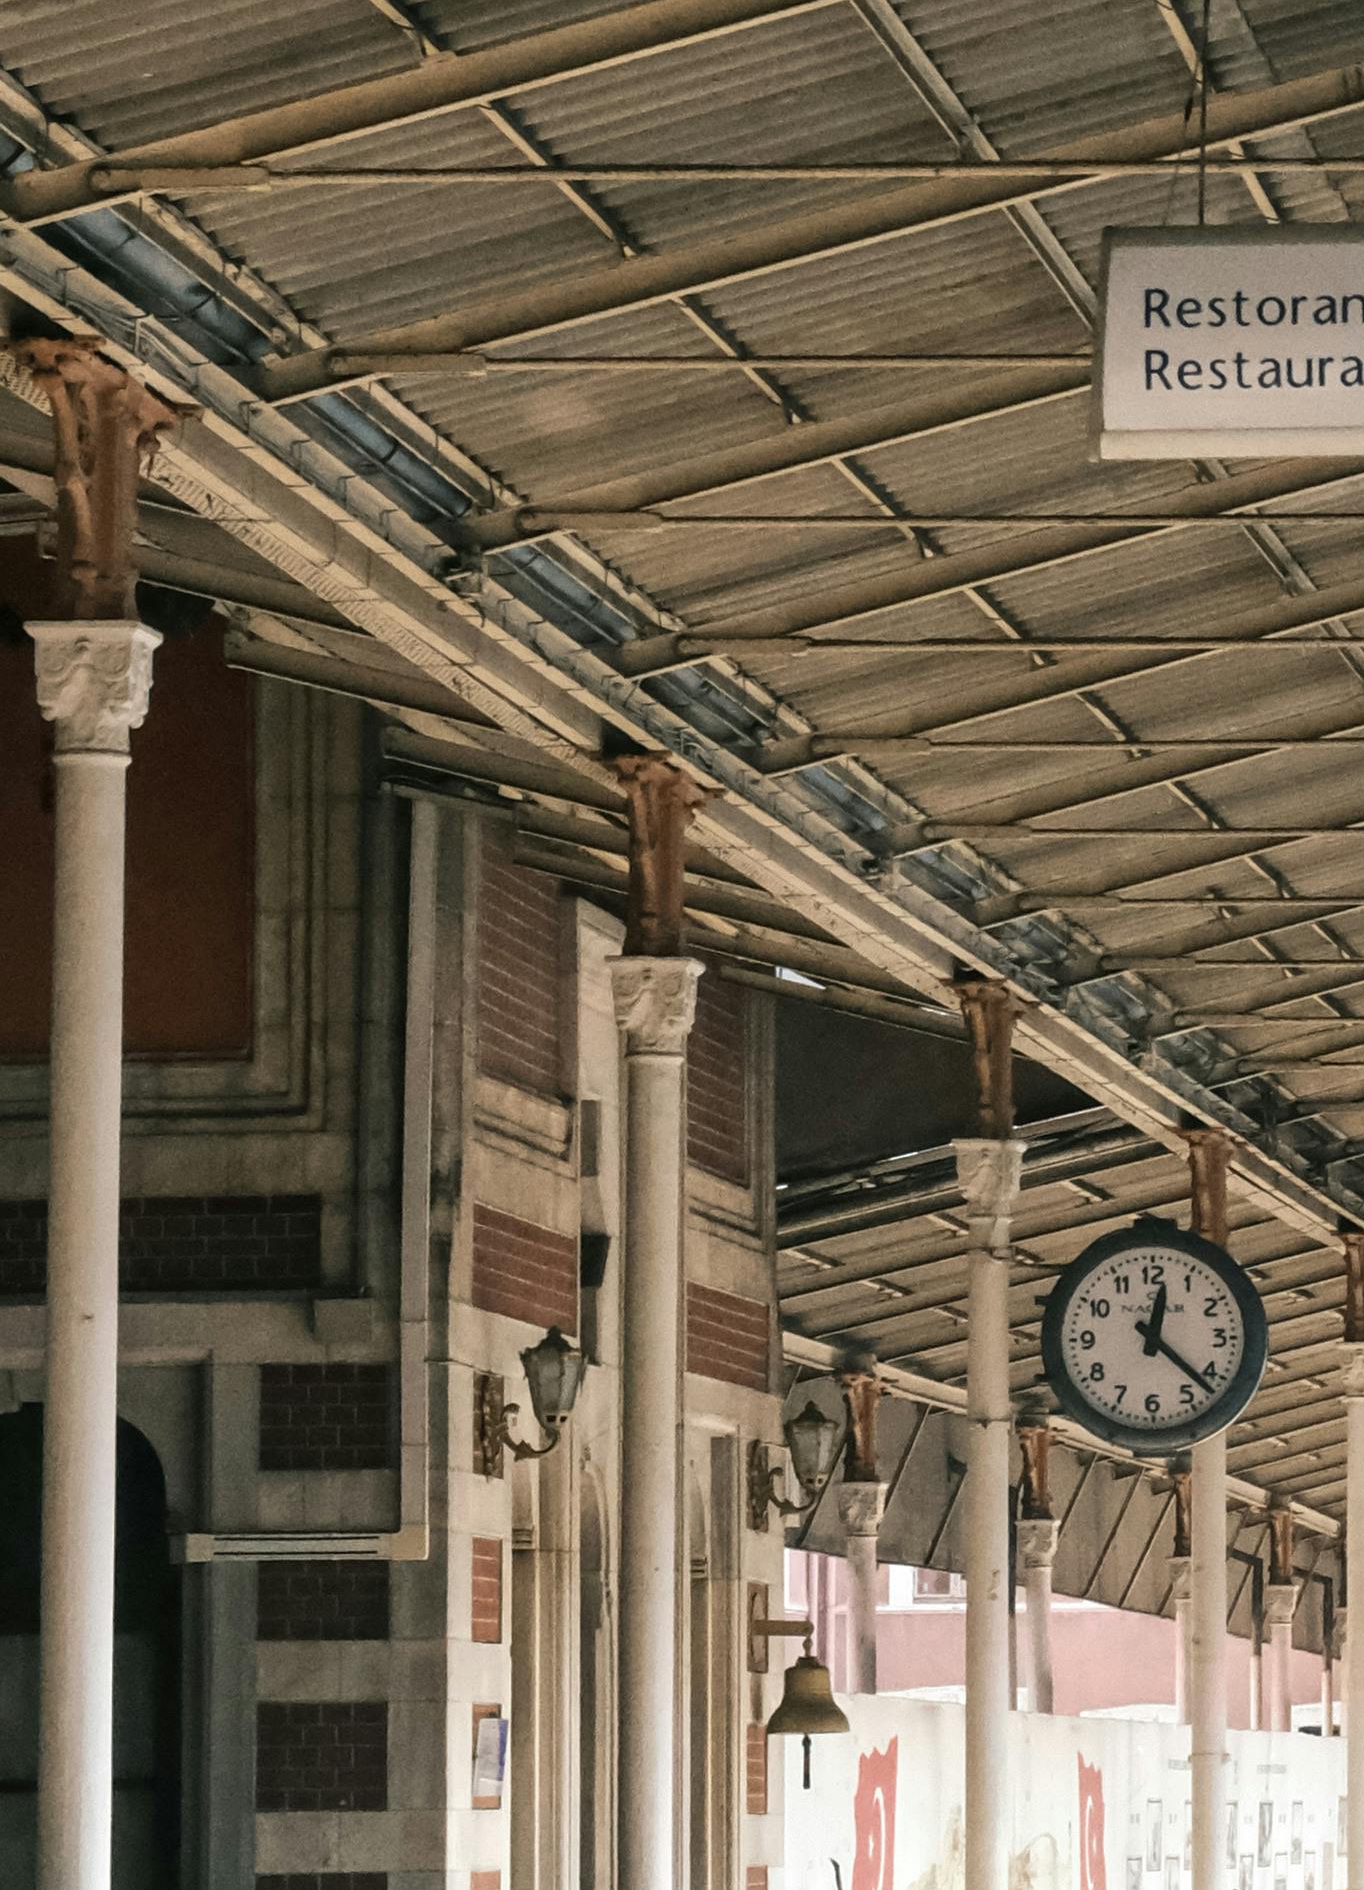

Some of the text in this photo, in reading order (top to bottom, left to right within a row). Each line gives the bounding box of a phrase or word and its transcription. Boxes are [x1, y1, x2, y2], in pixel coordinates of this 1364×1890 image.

[1113, 1275, 1130, 1294] 11
[1141, 1265, 1165, 1285] 12
[1184, 1275, 1192, 1293] 1
[1089, 1298, 1111, 1318] 10
[1203, 1297, 1219, 1317] 2
[1079, 1330, 1096, 1350] 9
[1212, 1328, 1227, 1348] 3
[1089, 1362, 1105, 1382] 8
[1202, 1361, 1218, 1380] 4
[1113, 1385, 1128, 1404] 7
[1144, 1394, 1160, 1413] 6
[1179, 1384, 1195, 1404] 5
